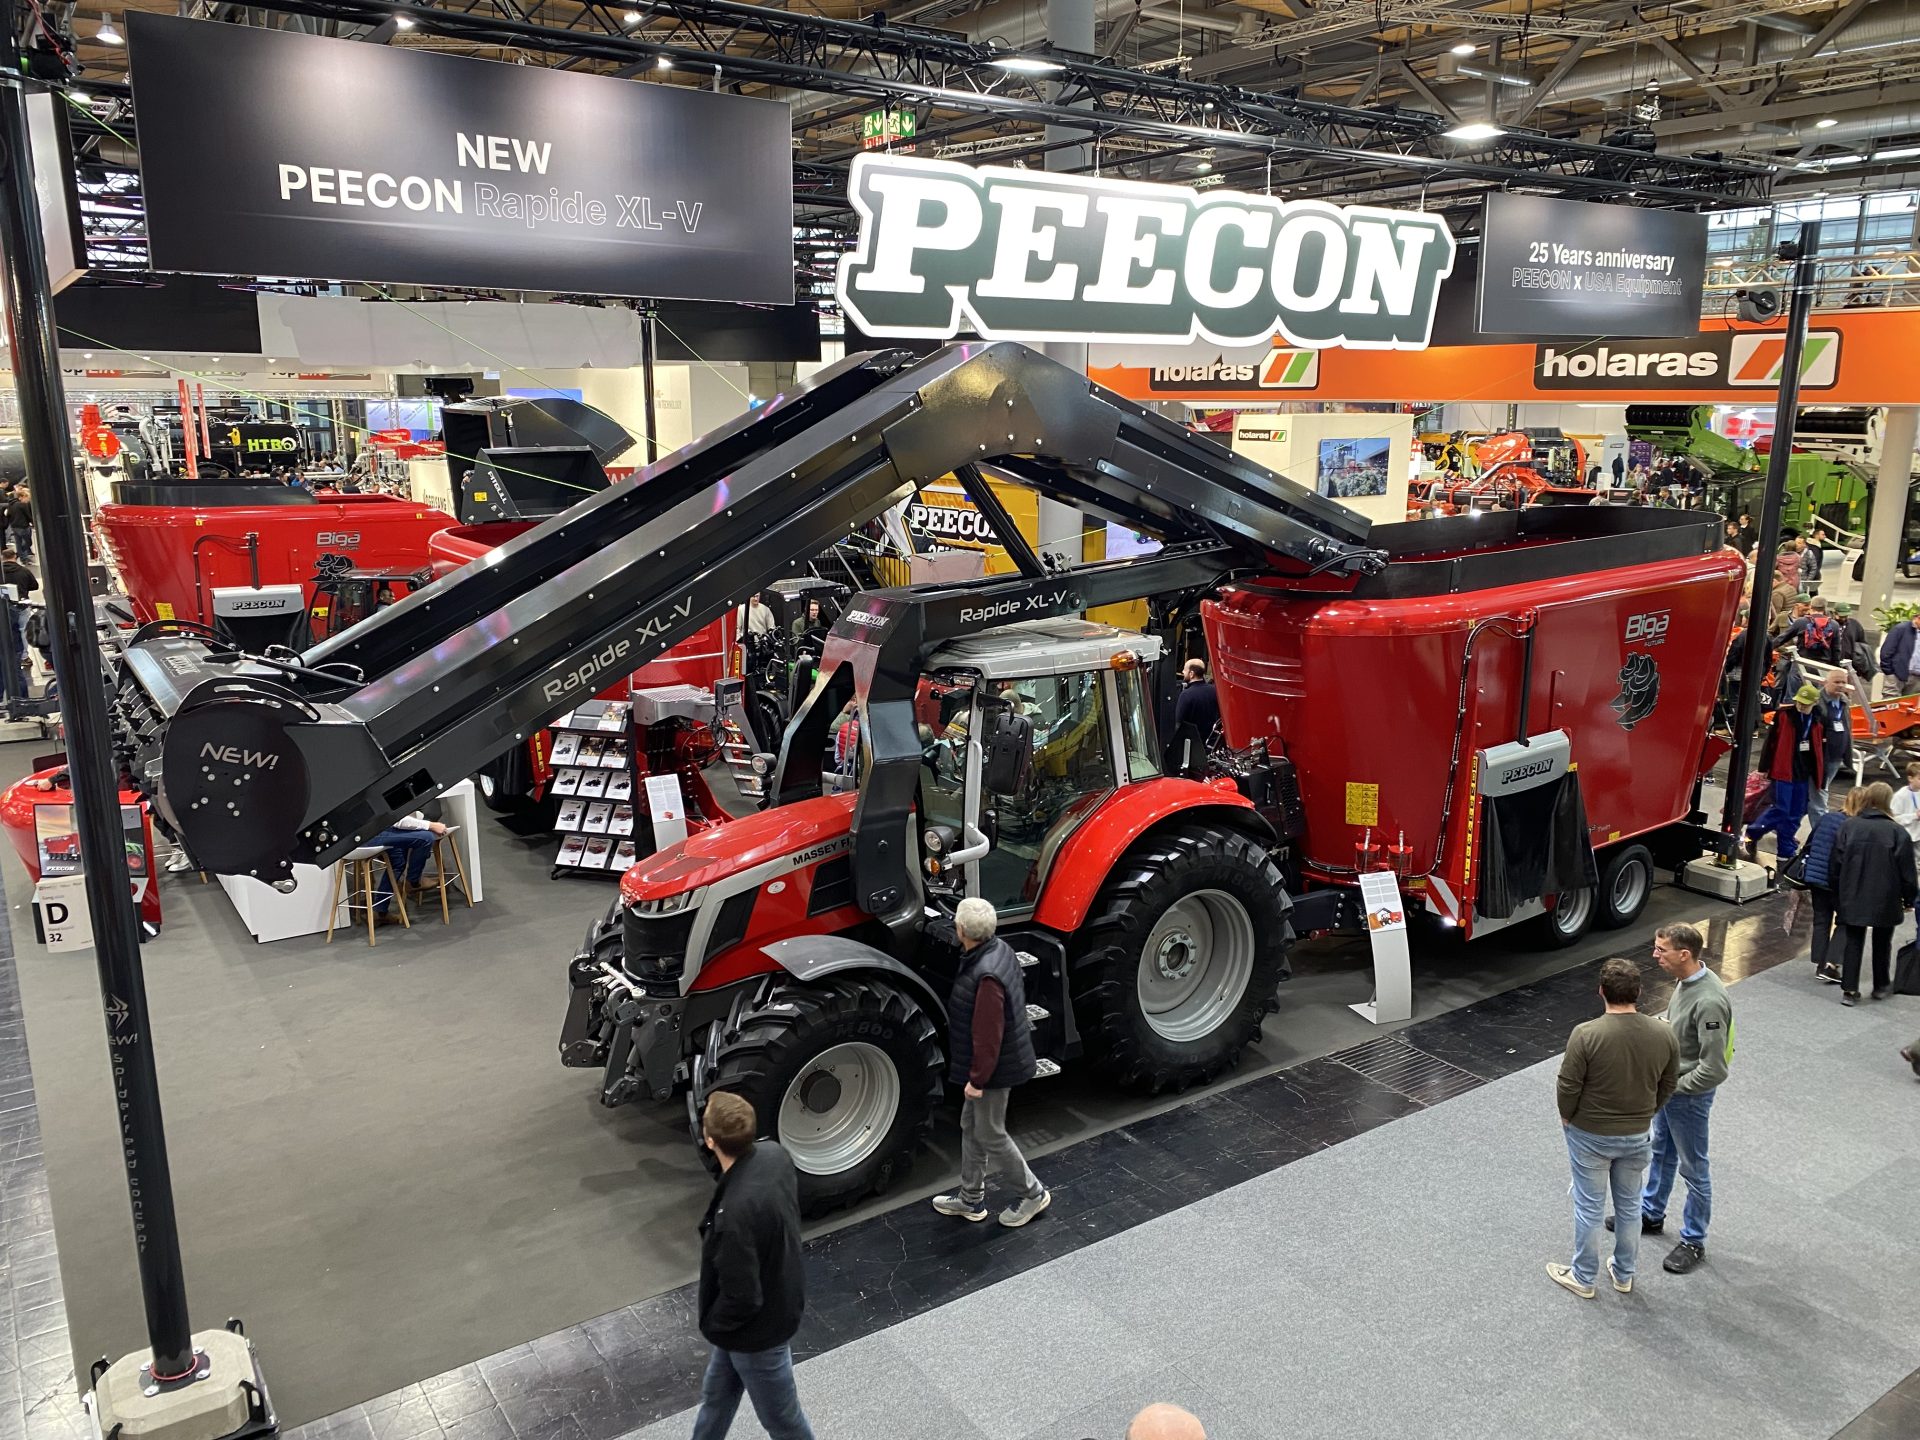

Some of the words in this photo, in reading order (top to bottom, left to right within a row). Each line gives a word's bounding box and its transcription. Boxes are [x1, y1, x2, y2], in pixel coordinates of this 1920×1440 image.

[456, 132, 552, 175] NEW
[278, 163, 464, 214] PEECON
[474, 182, 606, 228] Rapide
[614, 194, 703, 233] XL-V
[854, 172, 1436, 317] PEECON
[1529, 241, 1549, 264] 25
[1552, 243, 1592, 266] Years
[1595, 248, 1675, 276] anniversary
[1512, 267, 1572, 290] PEECON
[1573, 275, 1582, 290] x
[1585, 271, 1613, 292] USA
[1615, 273, 1683, 298] Equipment
[1542, 347, 1719, 378] holaras
[1239, 430, 1270, 440] holaras
[911, 505, 998, 539] PEECO
[316, 531, 361, 547] Biga
[231, 599, 286, 611] PEECON
[846, 609, 890, 629] PEECON
[960, 600, 1021, 624] Rapide
[1026, 589, 1067, 611] XL-V
[1625, 612, 1670, 639] Biga
[542, 639, 631, 703] Rapide
[635, 595, 692, 645] XL-V
[200, 742, 279, 770] NEW!
[1501, 758, 1554, 785] PEECON
[792, 841, 838, 866] MASSEY
[45, 902, 69, 925] D
[49, 933, 63, 943] 32
